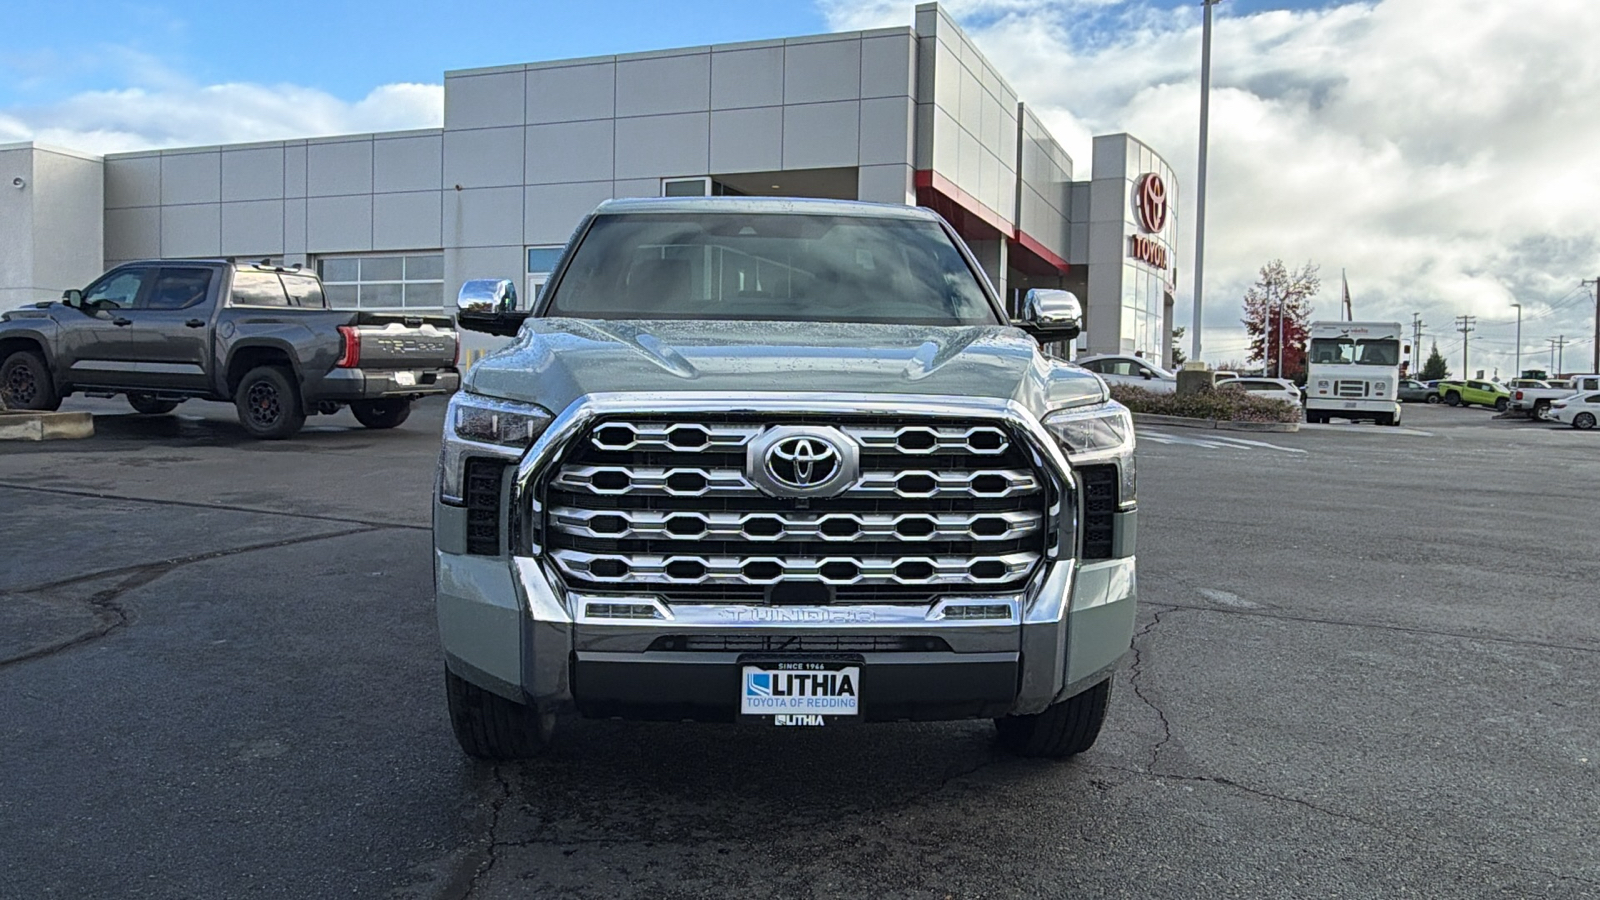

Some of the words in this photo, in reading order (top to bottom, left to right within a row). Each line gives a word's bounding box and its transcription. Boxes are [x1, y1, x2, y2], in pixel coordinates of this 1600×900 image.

[772, 674, 855, 696] LITHIA
[747, 698, 787, 708] TOYOTA
[790, 698, 803, 708] OF
[806, 698, 856, 708] REDDING
[786, 715, 825, 726] LITHIA
